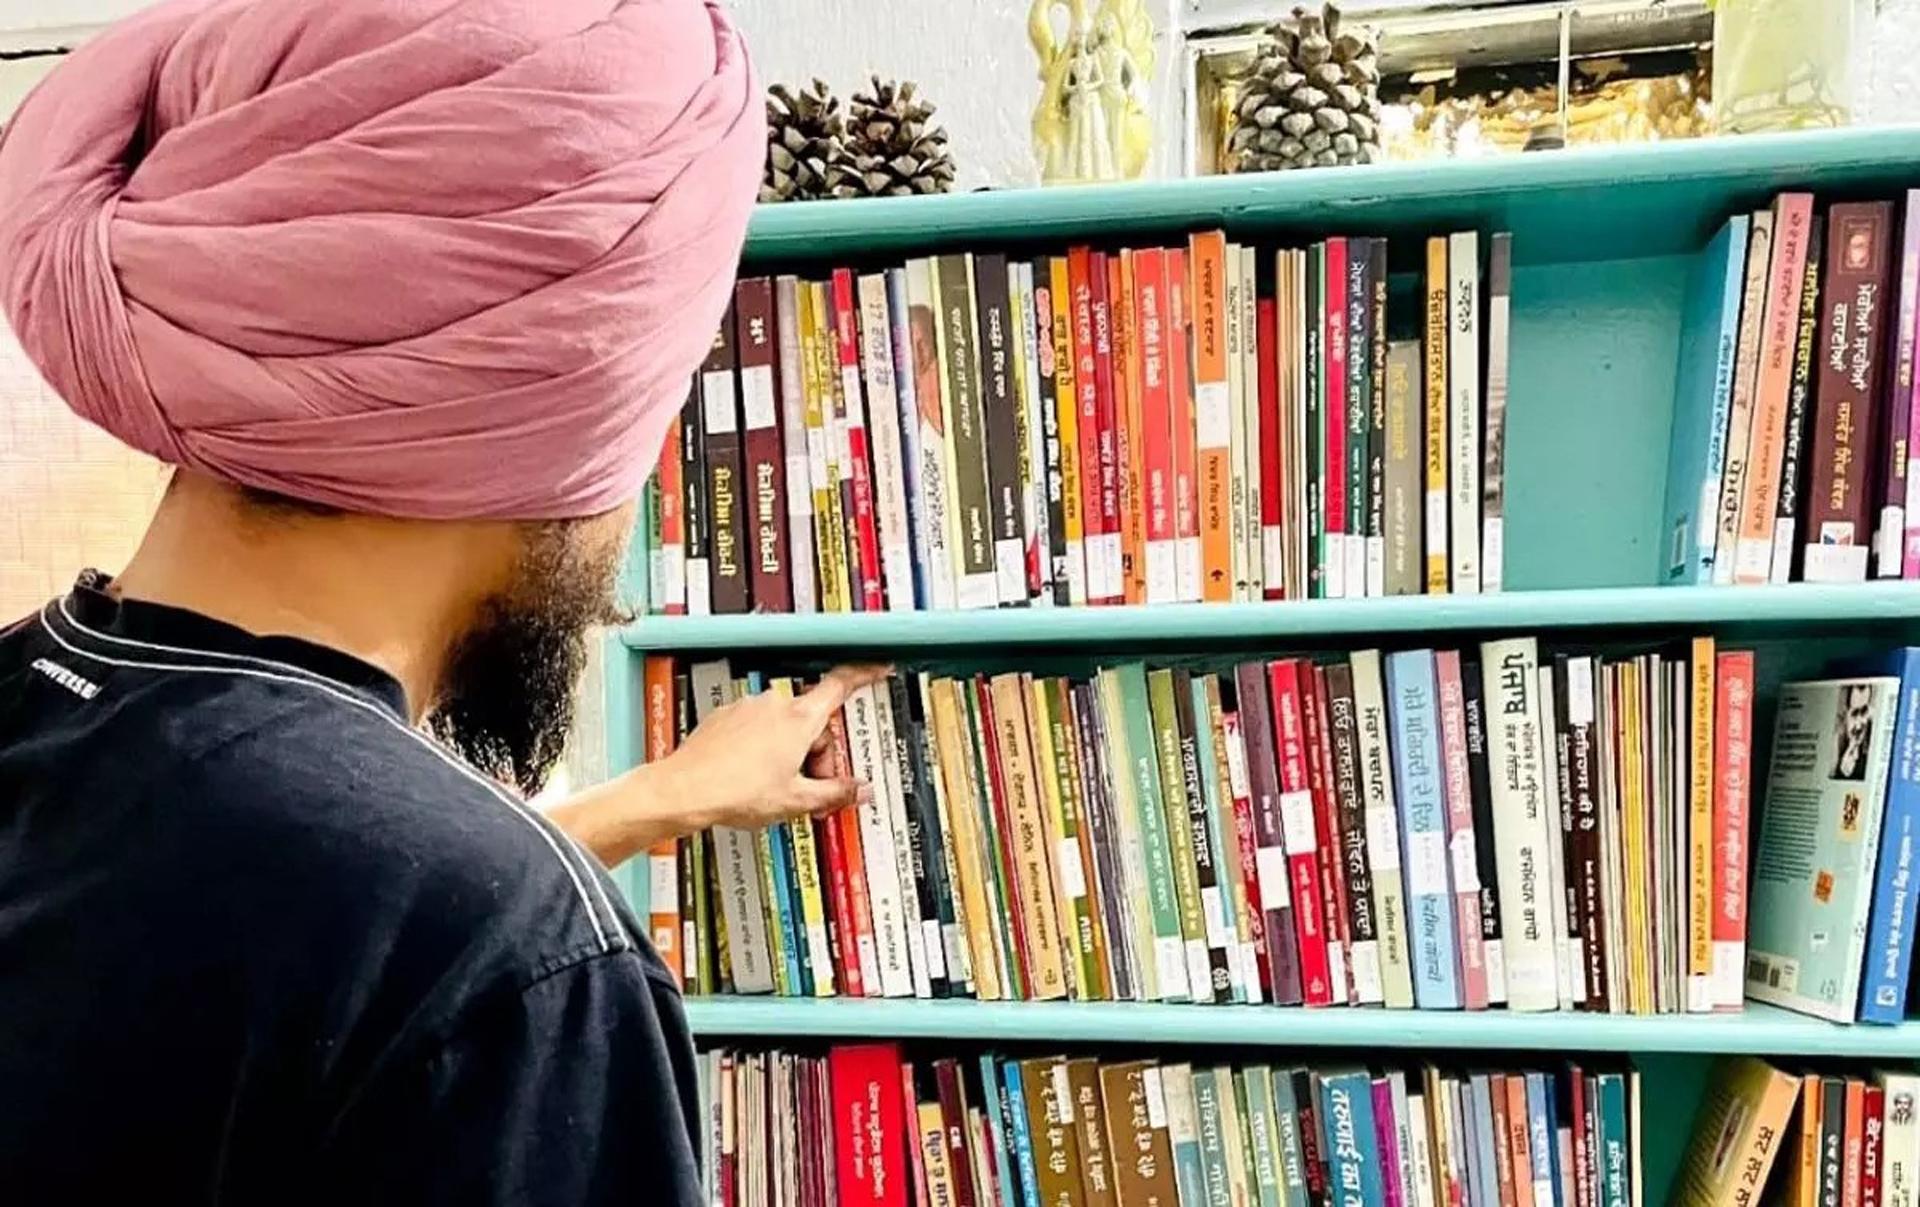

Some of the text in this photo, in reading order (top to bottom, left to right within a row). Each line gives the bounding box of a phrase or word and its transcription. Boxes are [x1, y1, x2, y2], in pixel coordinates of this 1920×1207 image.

[1828, 302, 1851, 372] ਕਹਾਣੀਆਂ
[1500, 652, 1534, 716] ਪੰਜਾਬ
[1363, 705, 1387, 803] ਮੇਰਾ ਬਚਪਨ
[1338, 1161, 1362, 1193] का
